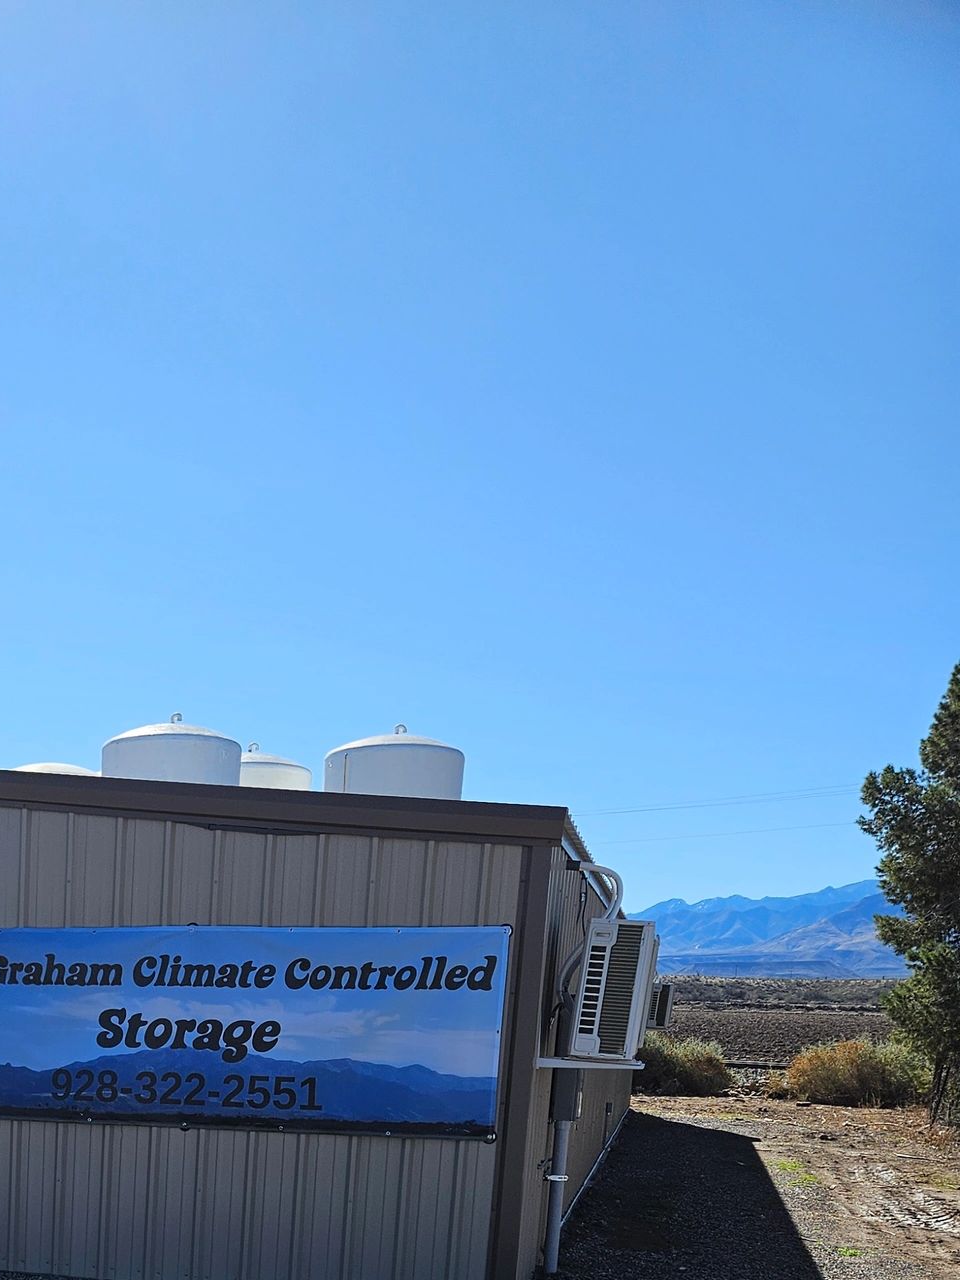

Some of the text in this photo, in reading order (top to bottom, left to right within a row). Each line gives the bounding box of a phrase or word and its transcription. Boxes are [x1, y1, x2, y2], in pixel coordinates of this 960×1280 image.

[132, 954, 277, 989] Climate
[284, 955, 498, 991] Controlled
[95, 1007, 282, 1063] Storage
[50, 1068, 323, 1111] 928-322-2551
